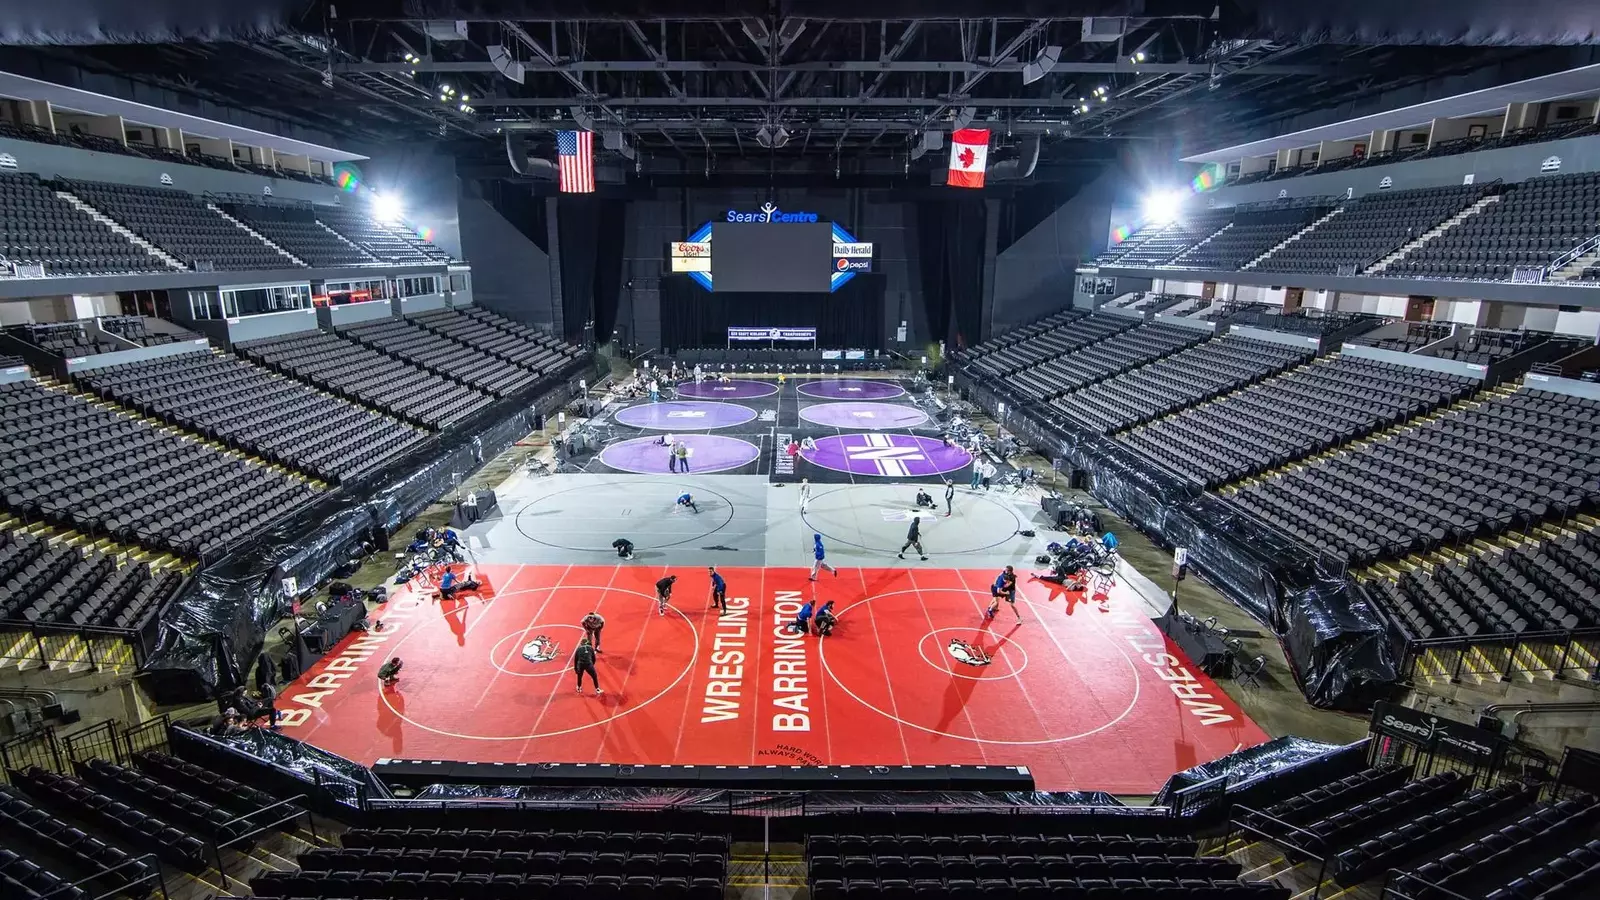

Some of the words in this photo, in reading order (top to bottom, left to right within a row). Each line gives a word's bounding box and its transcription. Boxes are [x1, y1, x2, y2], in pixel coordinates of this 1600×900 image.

[727, 210, 767, 222] Sears
[771, 210, 818, 223] Centre
[678, 243, 704, 252] Coors
[835, 246, 850, 254] Daily
[851, 246, 871, 254] Herald
[701, 597, 749, 723] WRESTLING
[772, 590, 811, 731] BARRINGTON
[1382, 714, 1430, 737] Sears
[758, 750, 796, 759] ALWAYS
[776, 744, 802, 754] HARD
[803, 751, 825, 766] WOR
